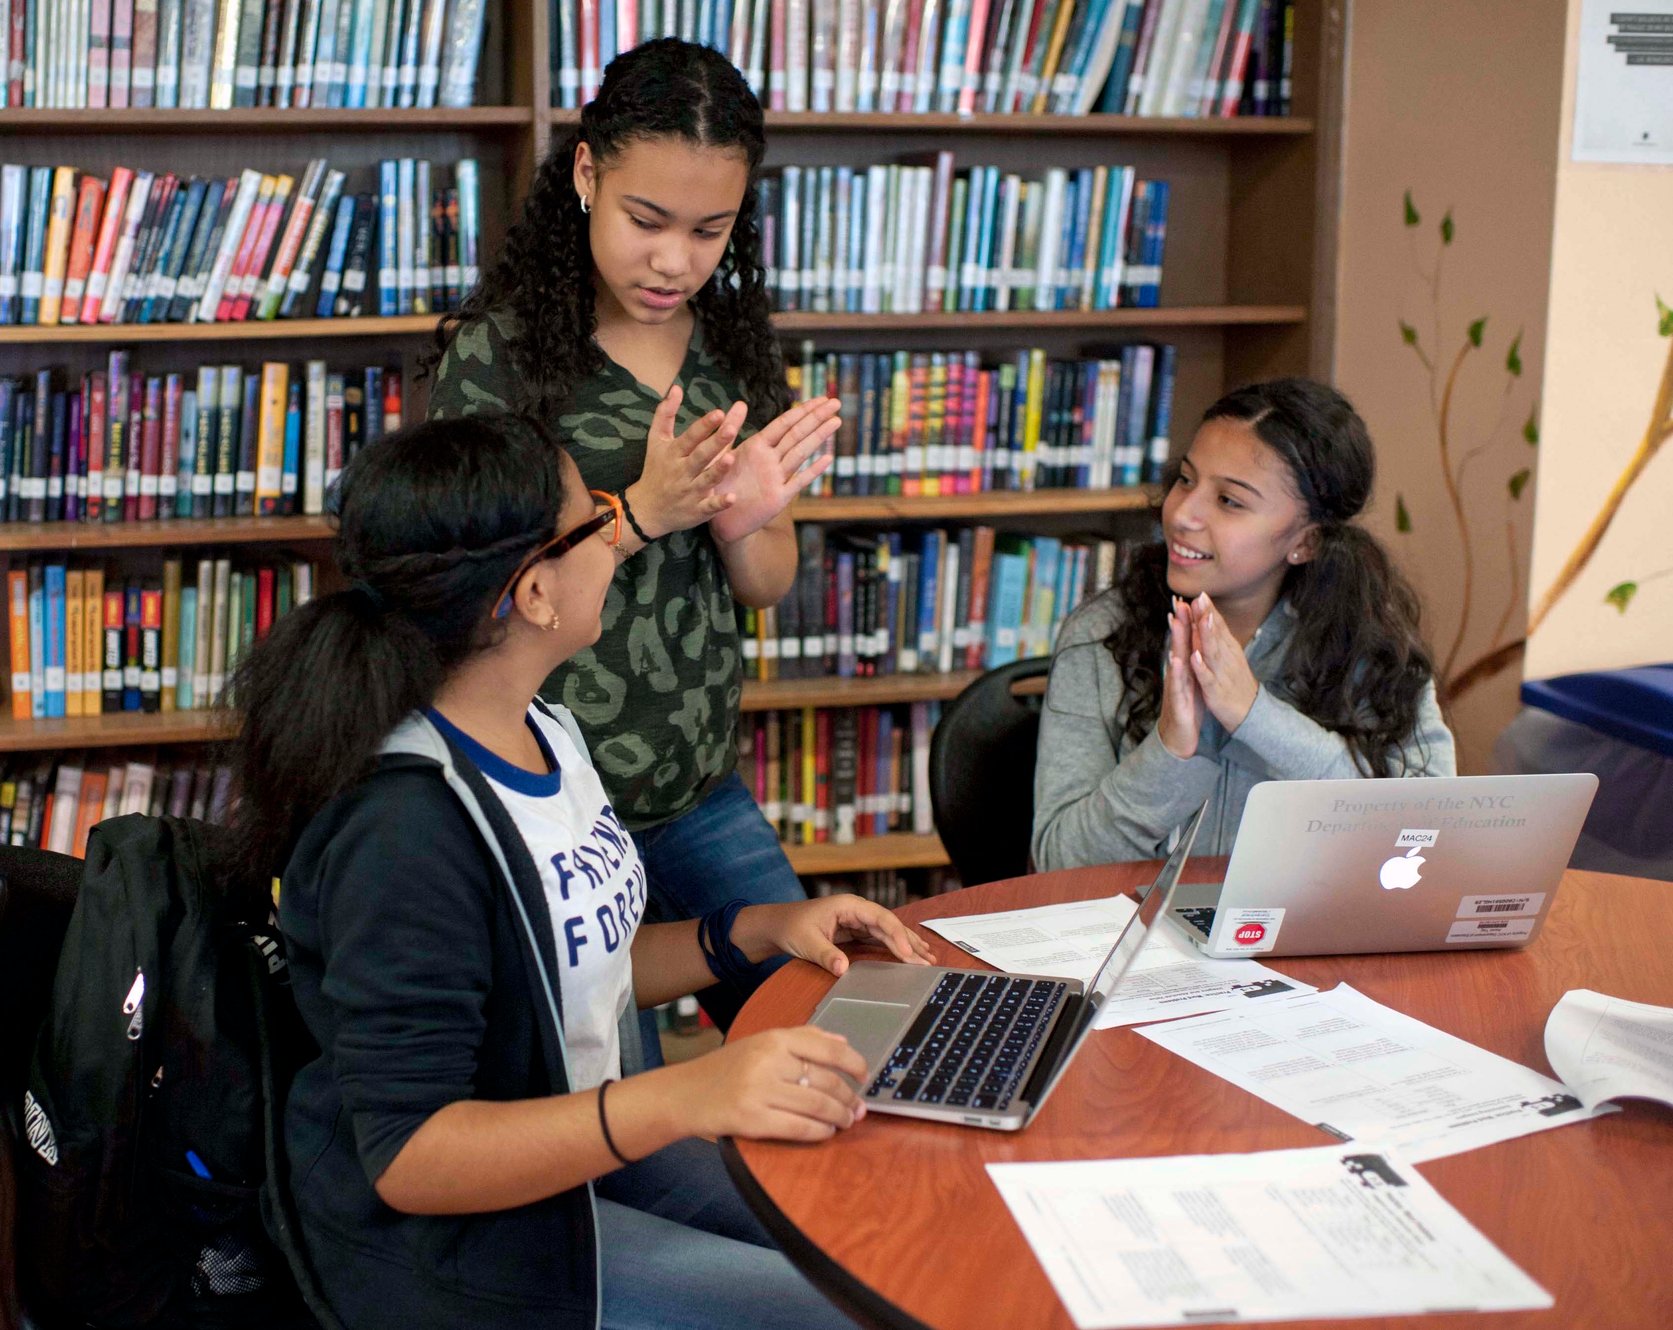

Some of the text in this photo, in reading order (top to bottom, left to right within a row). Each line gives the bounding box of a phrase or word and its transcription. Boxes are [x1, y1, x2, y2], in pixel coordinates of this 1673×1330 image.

[1436, 797, 1465, 810] the
[1469, 795, 1515, 810] NYC
[1400, 834, 1433, 842] MAC24
[1238, 930, 1262, 939] STOP
